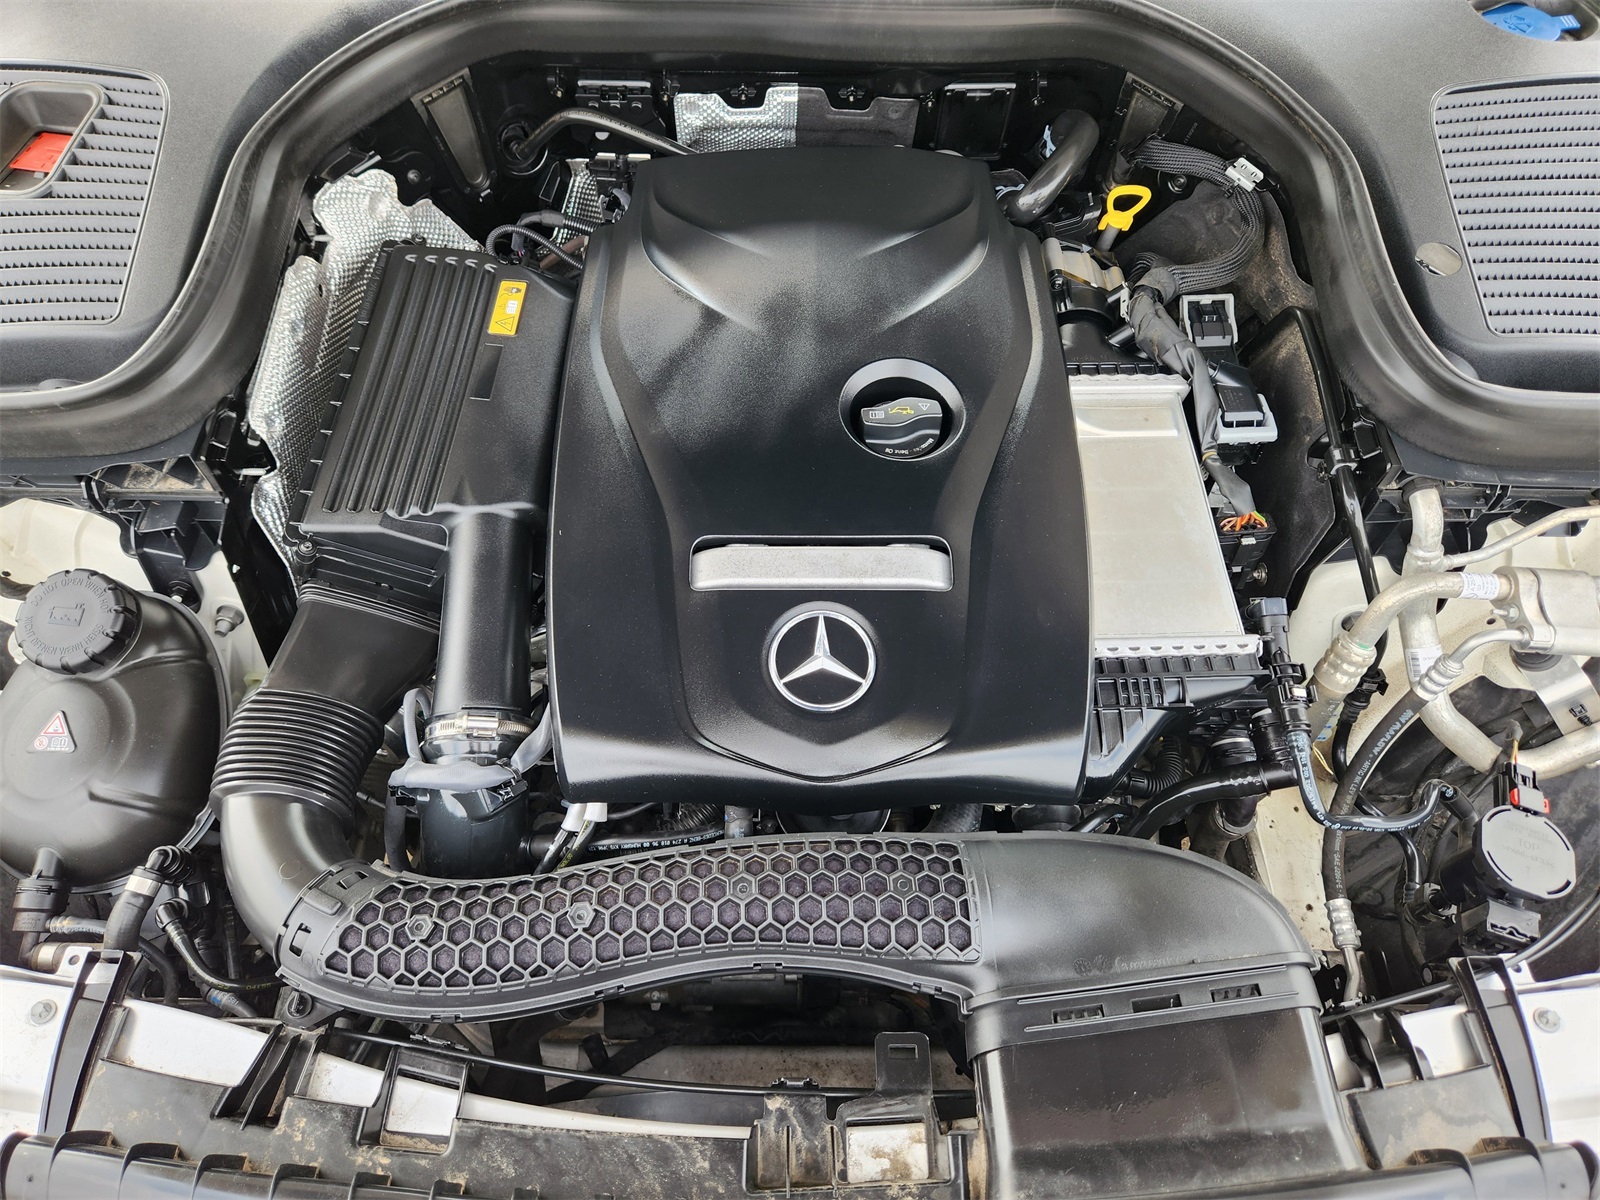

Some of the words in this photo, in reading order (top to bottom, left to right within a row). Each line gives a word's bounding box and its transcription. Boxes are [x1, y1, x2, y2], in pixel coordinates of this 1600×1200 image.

[31, 595, 43, 607] DO
[43, 582, 58, 596] NOT
[60, 577, 84, 588] OPEN
[84, 580, 106, 599] WHEN
[98, 597, 111, 615] HOT
[59, 642, 84, 655] WENN
[1372, 721, 1402, 756] MAFLOW
